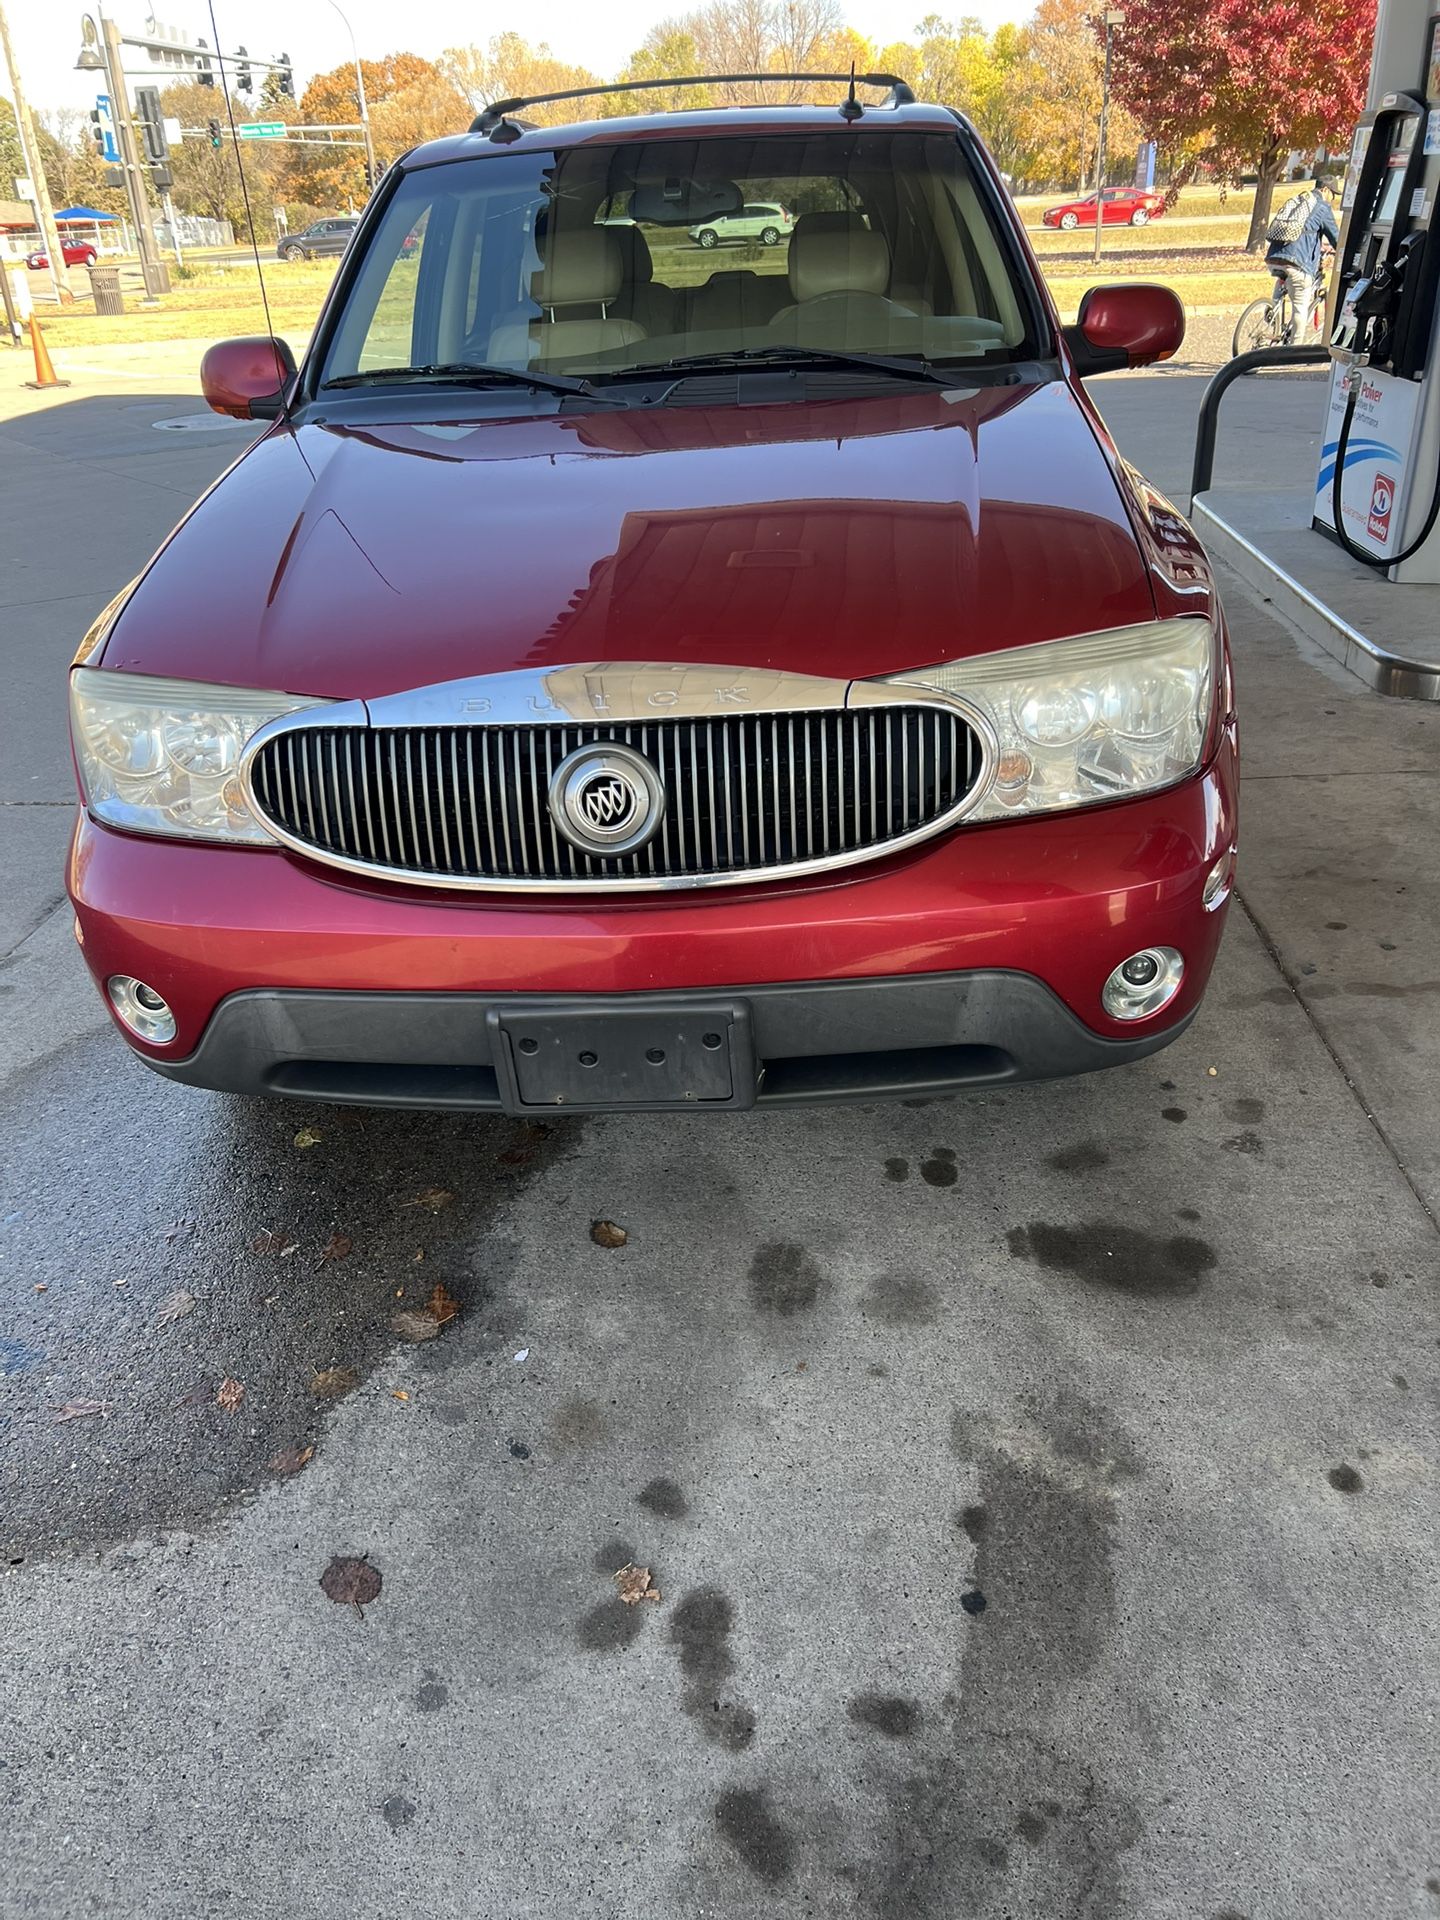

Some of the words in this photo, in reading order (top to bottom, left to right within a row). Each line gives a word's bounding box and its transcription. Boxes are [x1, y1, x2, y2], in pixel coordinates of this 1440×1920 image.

[1361, 382, 1383, 403] Power
[1369, 516, 1387, 539] Holiday
[459, 686, 750, 714] BUICK
